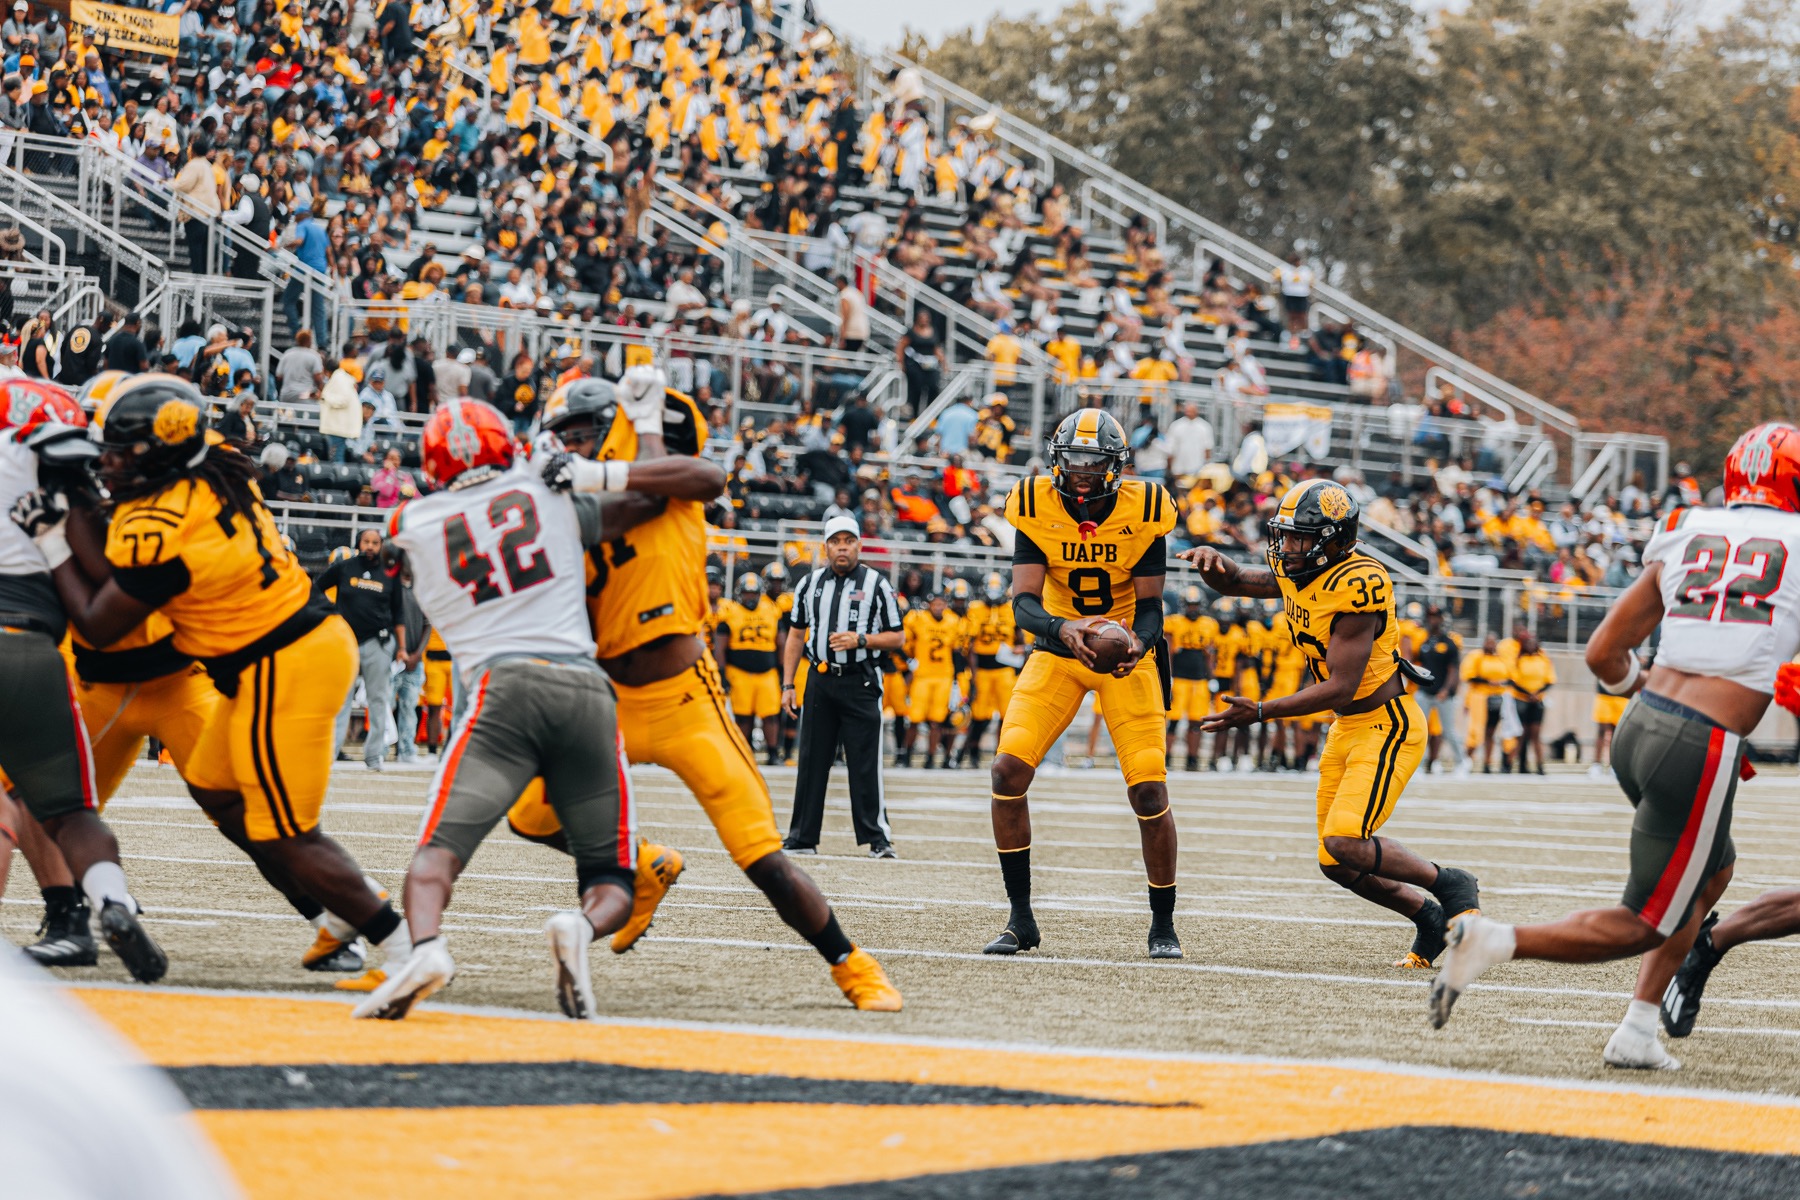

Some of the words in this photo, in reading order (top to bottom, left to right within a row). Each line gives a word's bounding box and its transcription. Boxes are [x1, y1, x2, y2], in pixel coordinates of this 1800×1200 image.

[123, 531, 164, 566] 77
[444, 489, 555, 606] 42
[1061, 542, 1118, 563] UAPB
[1068, 567, 1114, 616] 9
[1347, 573, 1386, 609] 32
[1668, 534, 1789, 626] 22
[1286, 595, 1310, 629] UAPB
[929, 637, 944, 662] 2
